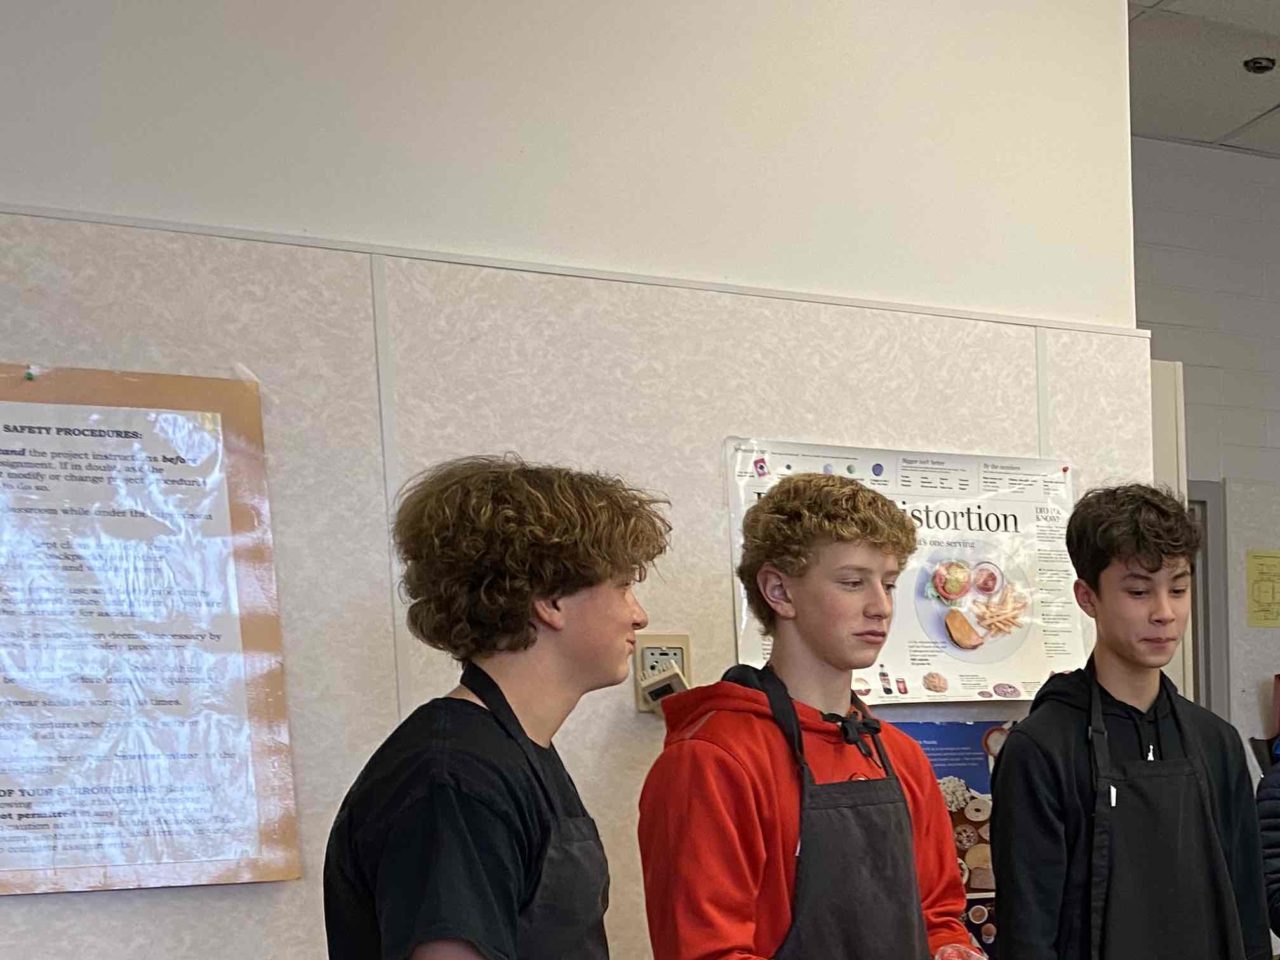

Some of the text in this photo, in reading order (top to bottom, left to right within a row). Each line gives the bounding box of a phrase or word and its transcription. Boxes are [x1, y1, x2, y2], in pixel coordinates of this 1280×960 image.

[3, 424, 142, 439] SAFETY PROCEDURES:
[29, 448, 47, 458] the
[50, 450, 89, 461] project
[59, 461, 69, 470] If
[147, 465, 165, 474] he
[8, 471, 46, 482] modify
[64, 473, 104, 484] change
[61, 507, 90, 516] while
[94, 508, 126, 518] under
[901, 500, 1021, 534] istortion
[208, 631, 222, 642] by
[0, 788, 14, 798] OF
